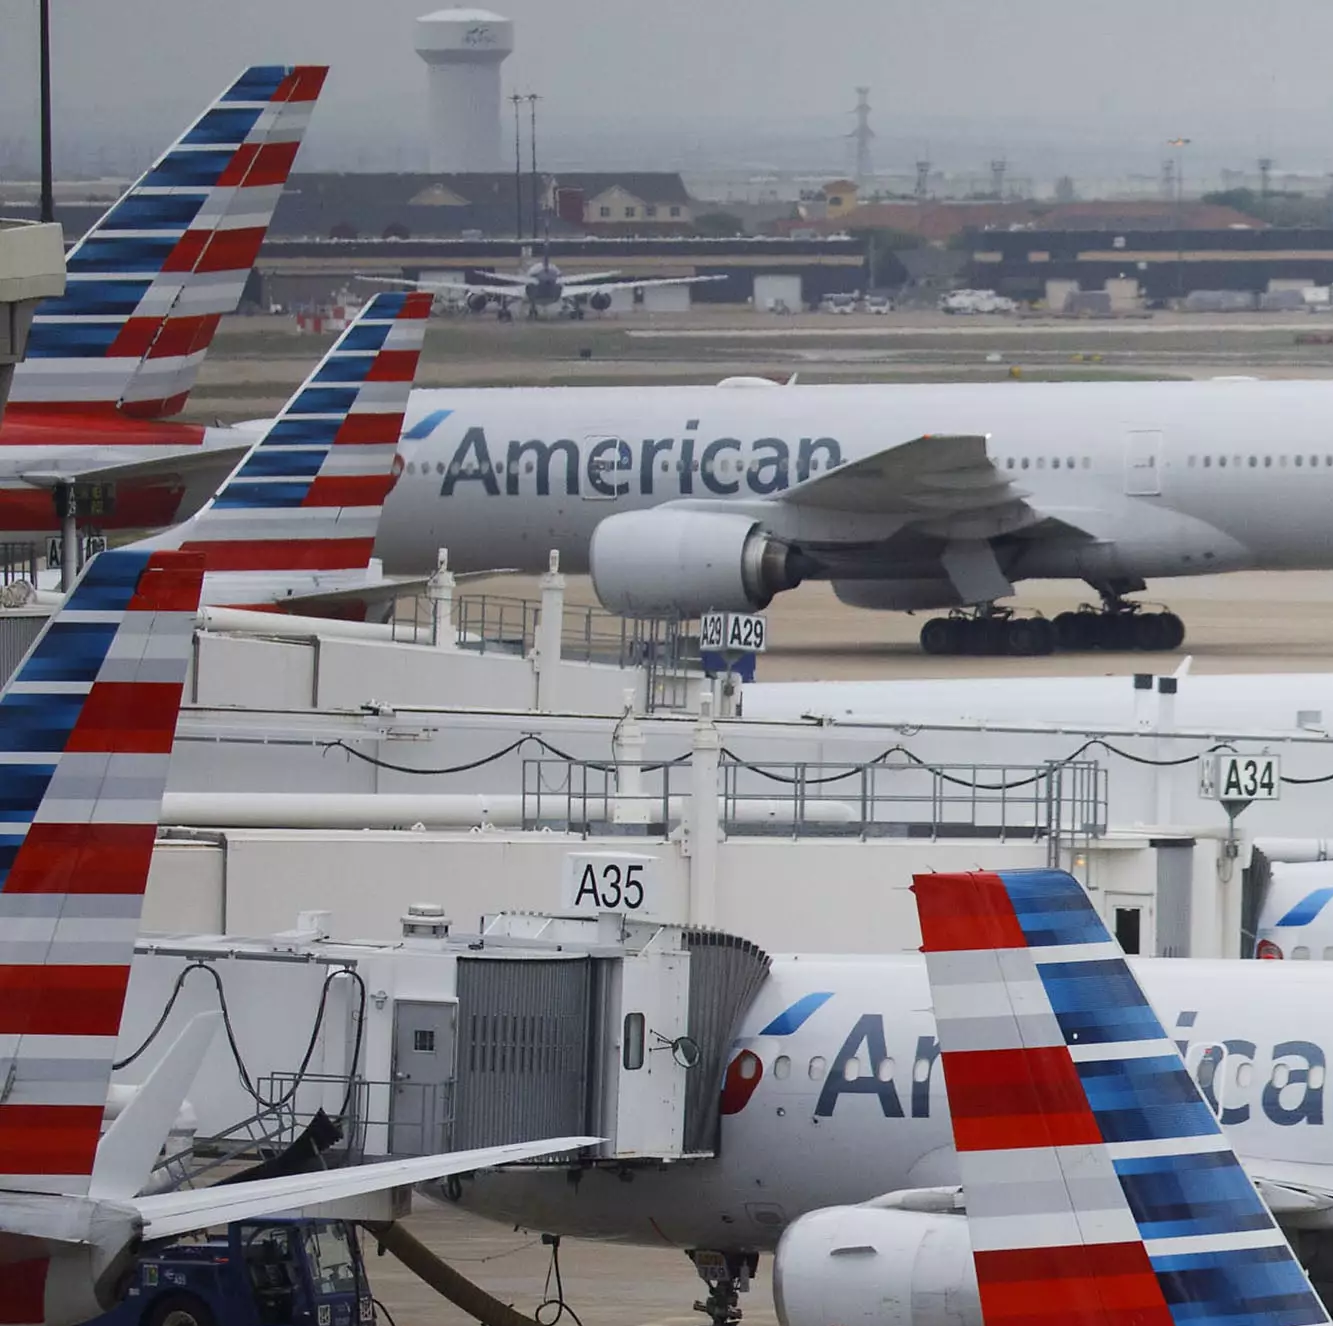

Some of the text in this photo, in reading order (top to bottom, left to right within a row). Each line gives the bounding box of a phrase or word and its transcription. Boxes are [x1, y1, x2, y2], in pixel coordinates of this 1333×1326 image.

[440, 419, 843, 496] American
[702, 616, 722, 646] A29
[730, 616, 764, 648] A29
[1224, 759, 1274, 797] A34
[575, 864, 644, 909] A35
